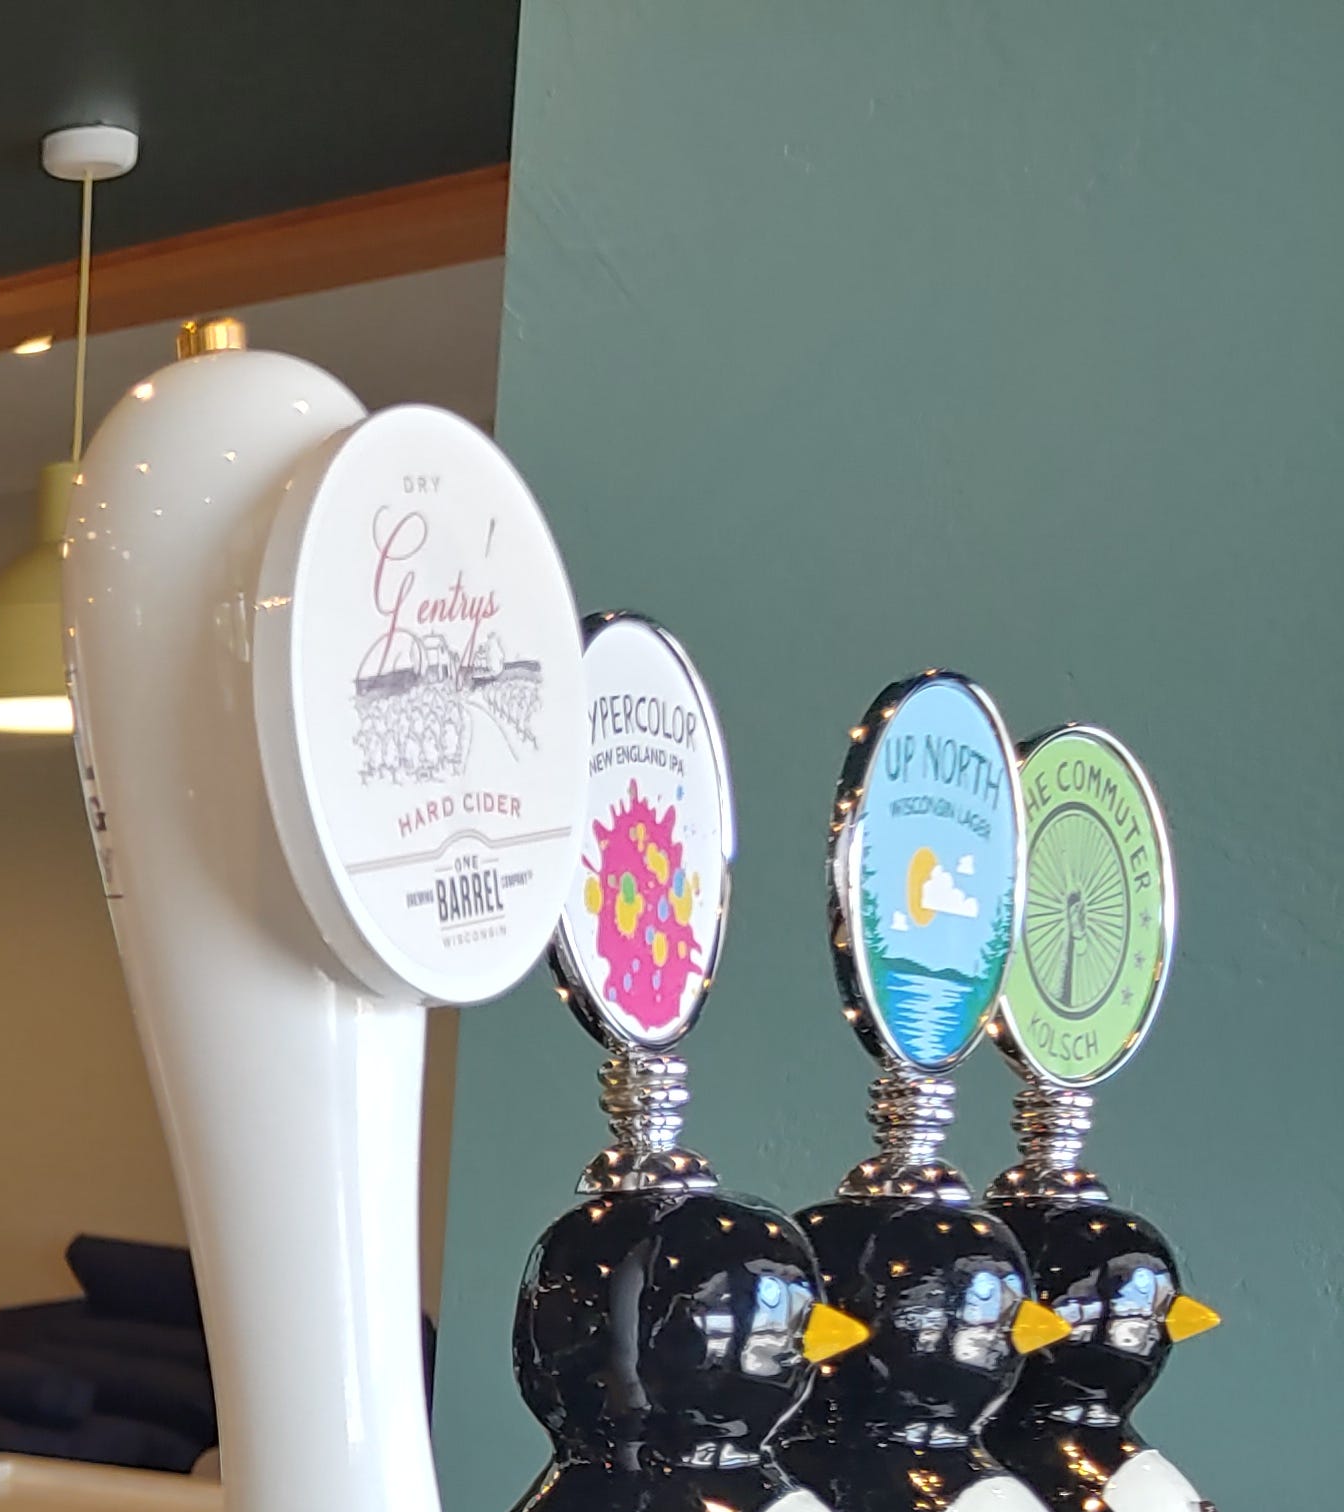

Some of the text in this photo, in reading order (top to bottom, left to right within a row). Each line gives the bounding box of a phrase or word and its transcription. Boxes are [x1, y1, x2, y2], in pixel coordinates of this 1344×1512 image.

[403, 475, 441, 494] DRY
[588, 694, 696, 752] YPERCOLOR
[589, 745, 684, 778] NEW ENGLAND IPA
[885, 734, 1004, 811] UP NORTH
[398, 792, 521, 838] HARD CIDER
[1025, 759, 1152, 895] HE COMMUTER
[454, 855, 479, 873] ONE
[435, 868, 504, 922] BARREL
[1028, 1010, 1099, 1060] KOLSCH
